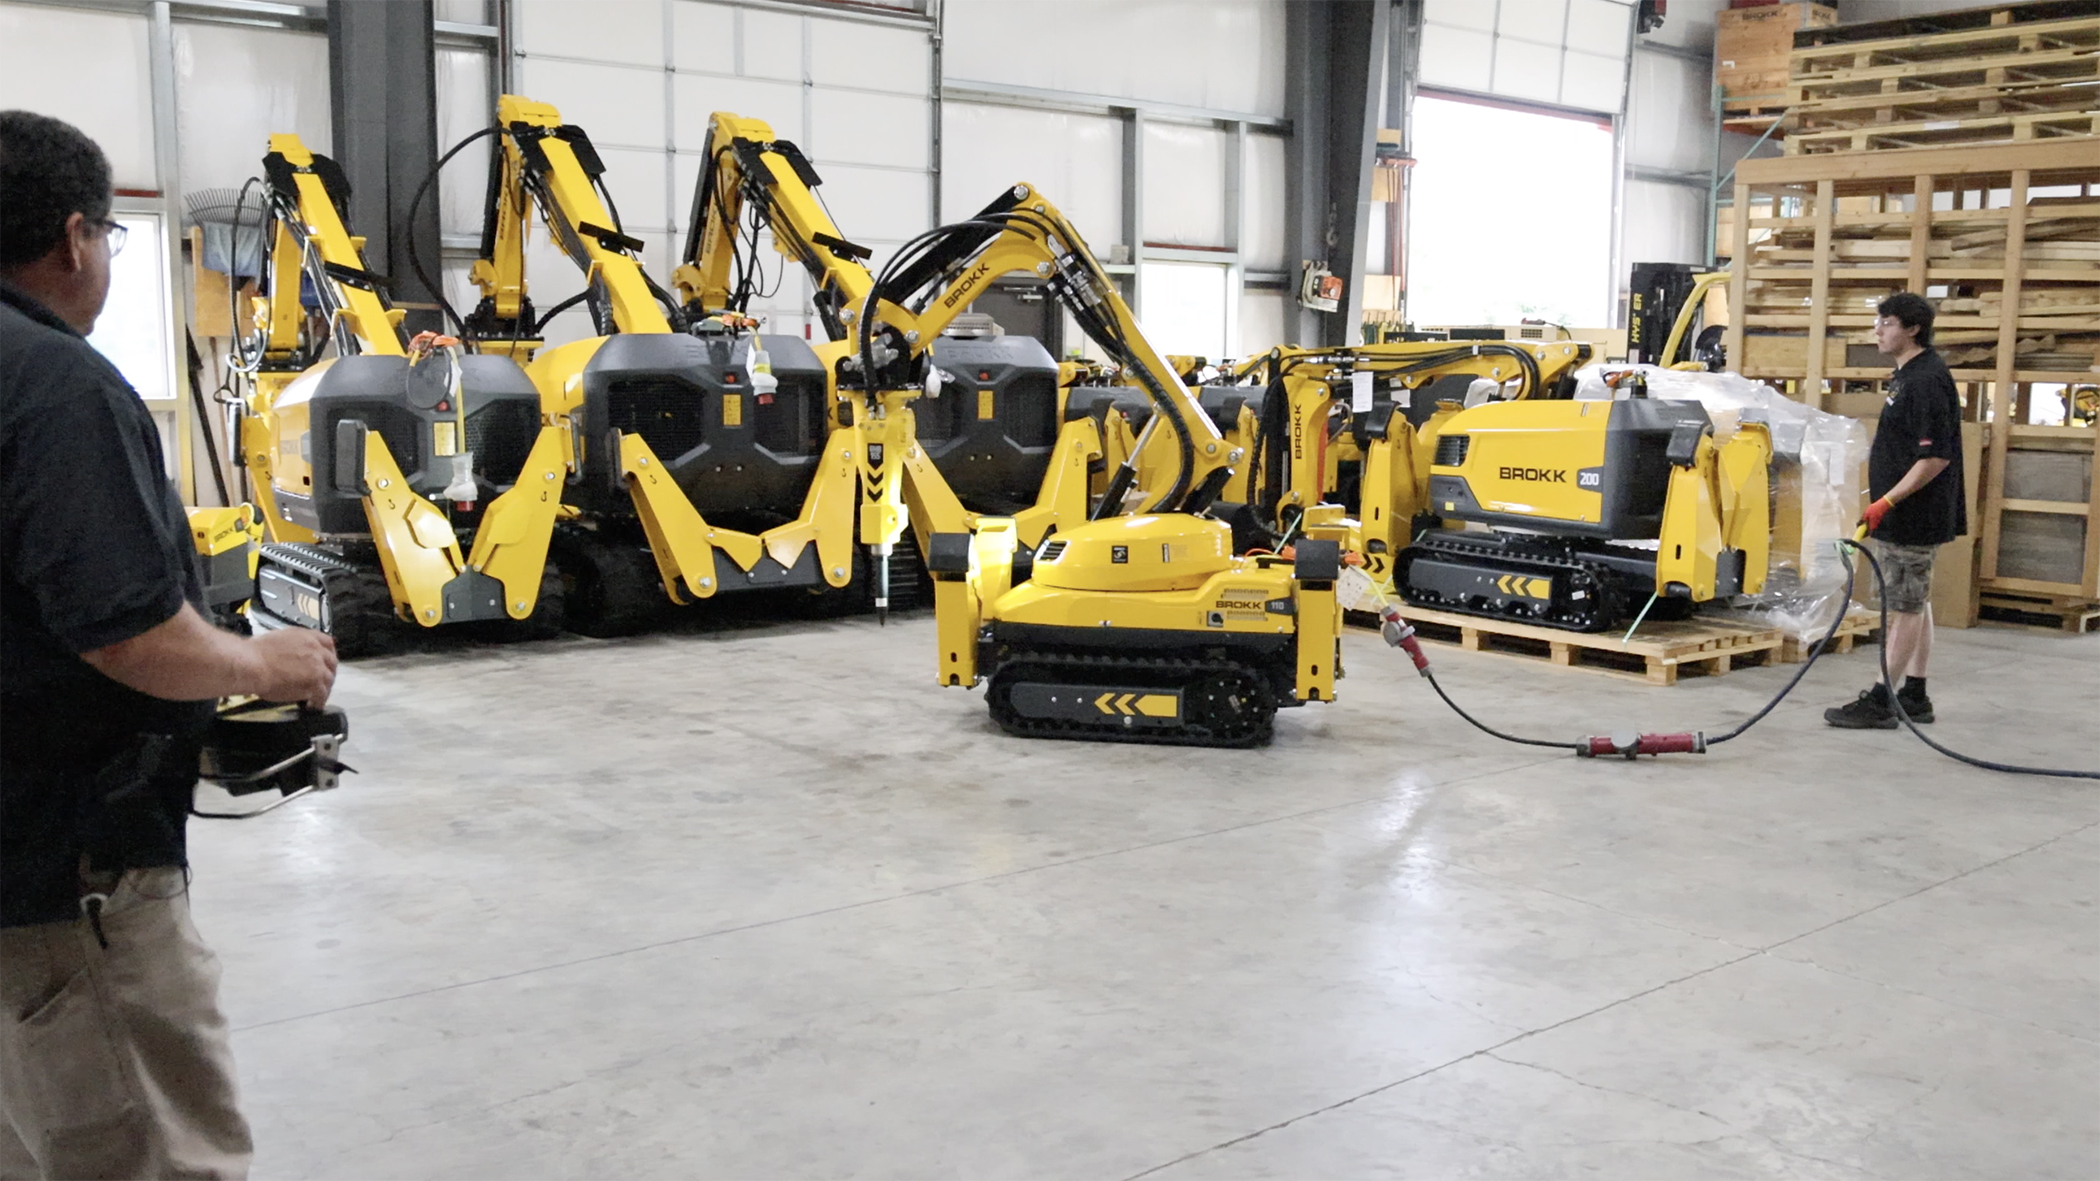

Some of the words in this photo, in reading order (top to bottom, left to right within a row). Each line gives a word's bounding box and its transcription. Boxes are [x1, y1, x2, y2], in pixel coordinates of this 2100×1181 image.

[944, 263, 990, 309] BROKK
[1294, 404, 1302, 460] BROKK
[1499, 467, 1567, 483] BROKK
[1579, 473, 1599, 486] 200
[1216, 600, 1262, 610] BROKK
[1271, 602, 1284, 610] 110
